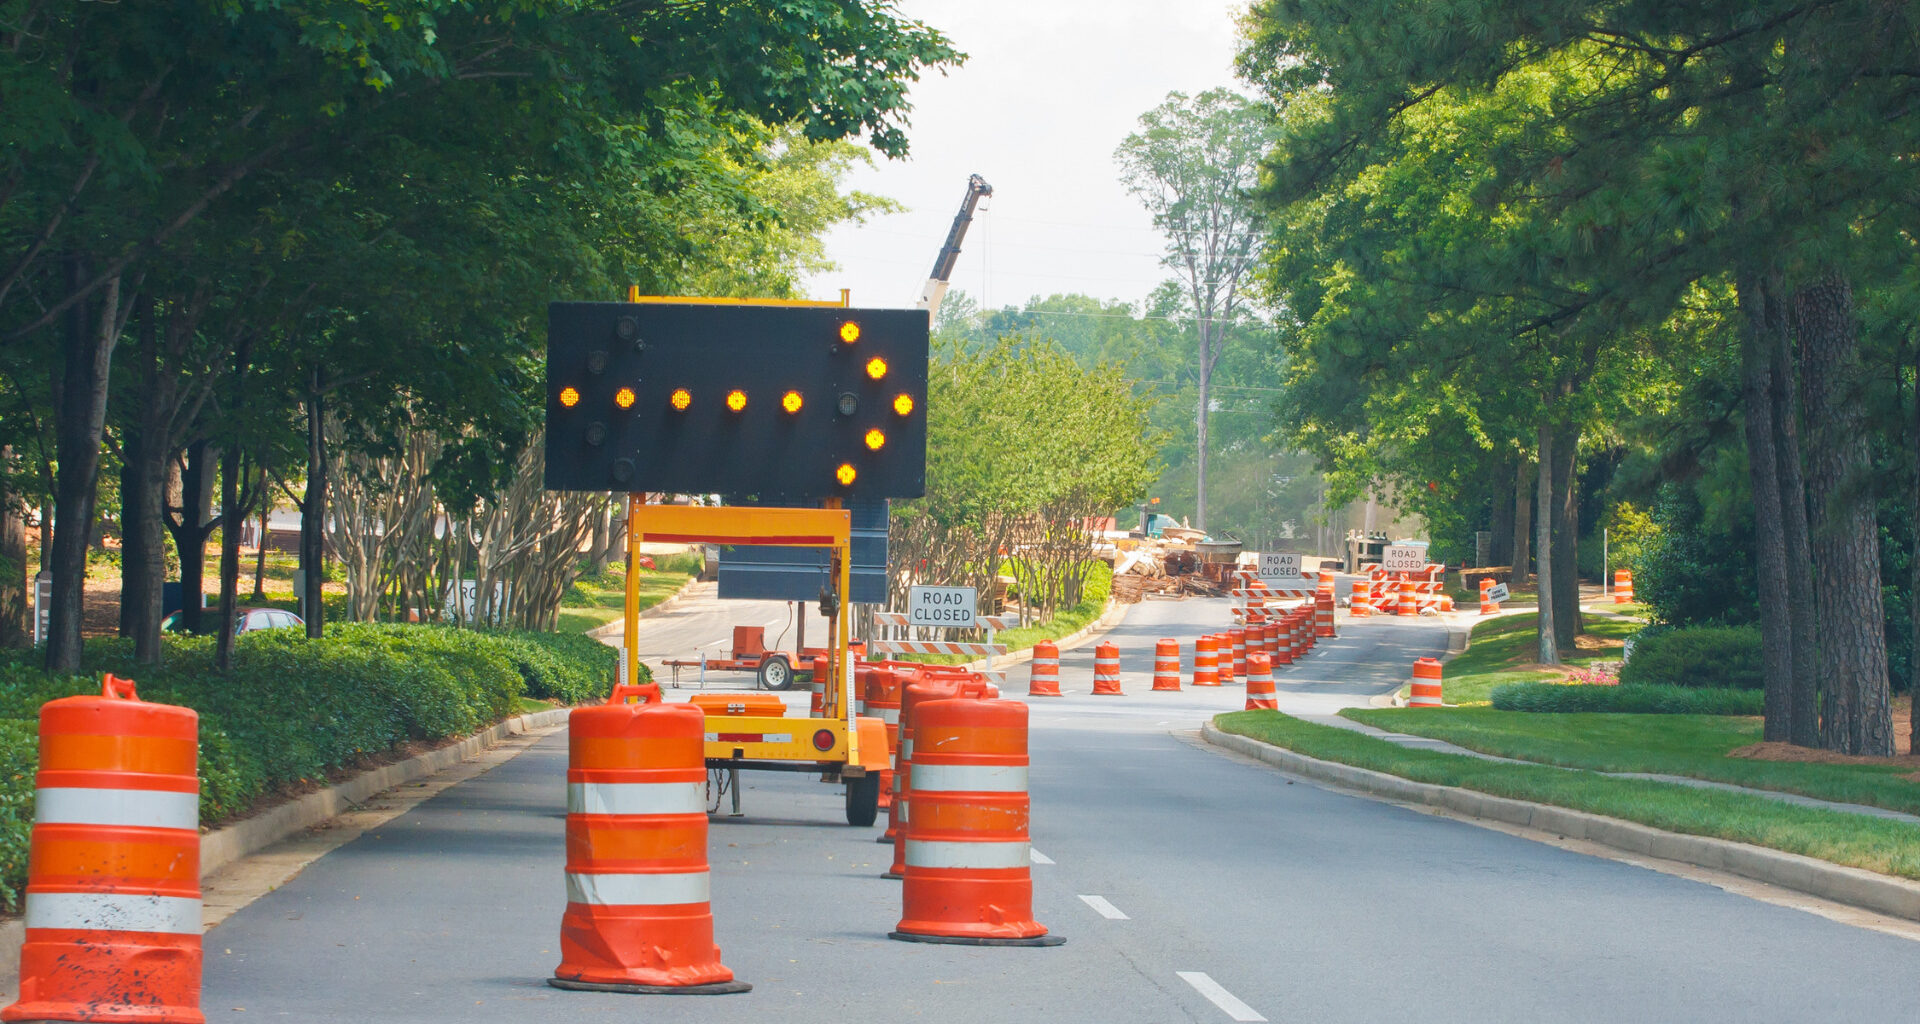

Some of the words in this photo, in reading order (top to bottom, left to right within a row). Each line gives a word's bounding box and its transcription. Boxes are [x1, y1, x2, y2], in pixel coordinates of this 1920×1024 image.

[1391, 550, 1417, 558] ROAD
[1267, 556, 1293, 565] ROAD
[1386, 560, 1421, 568] CLOSED
[1261, 567, 1298, 576] CLOSED
[923, 592, 963, 605] ROAD
[914, 608, 971, 621] CLOSED
